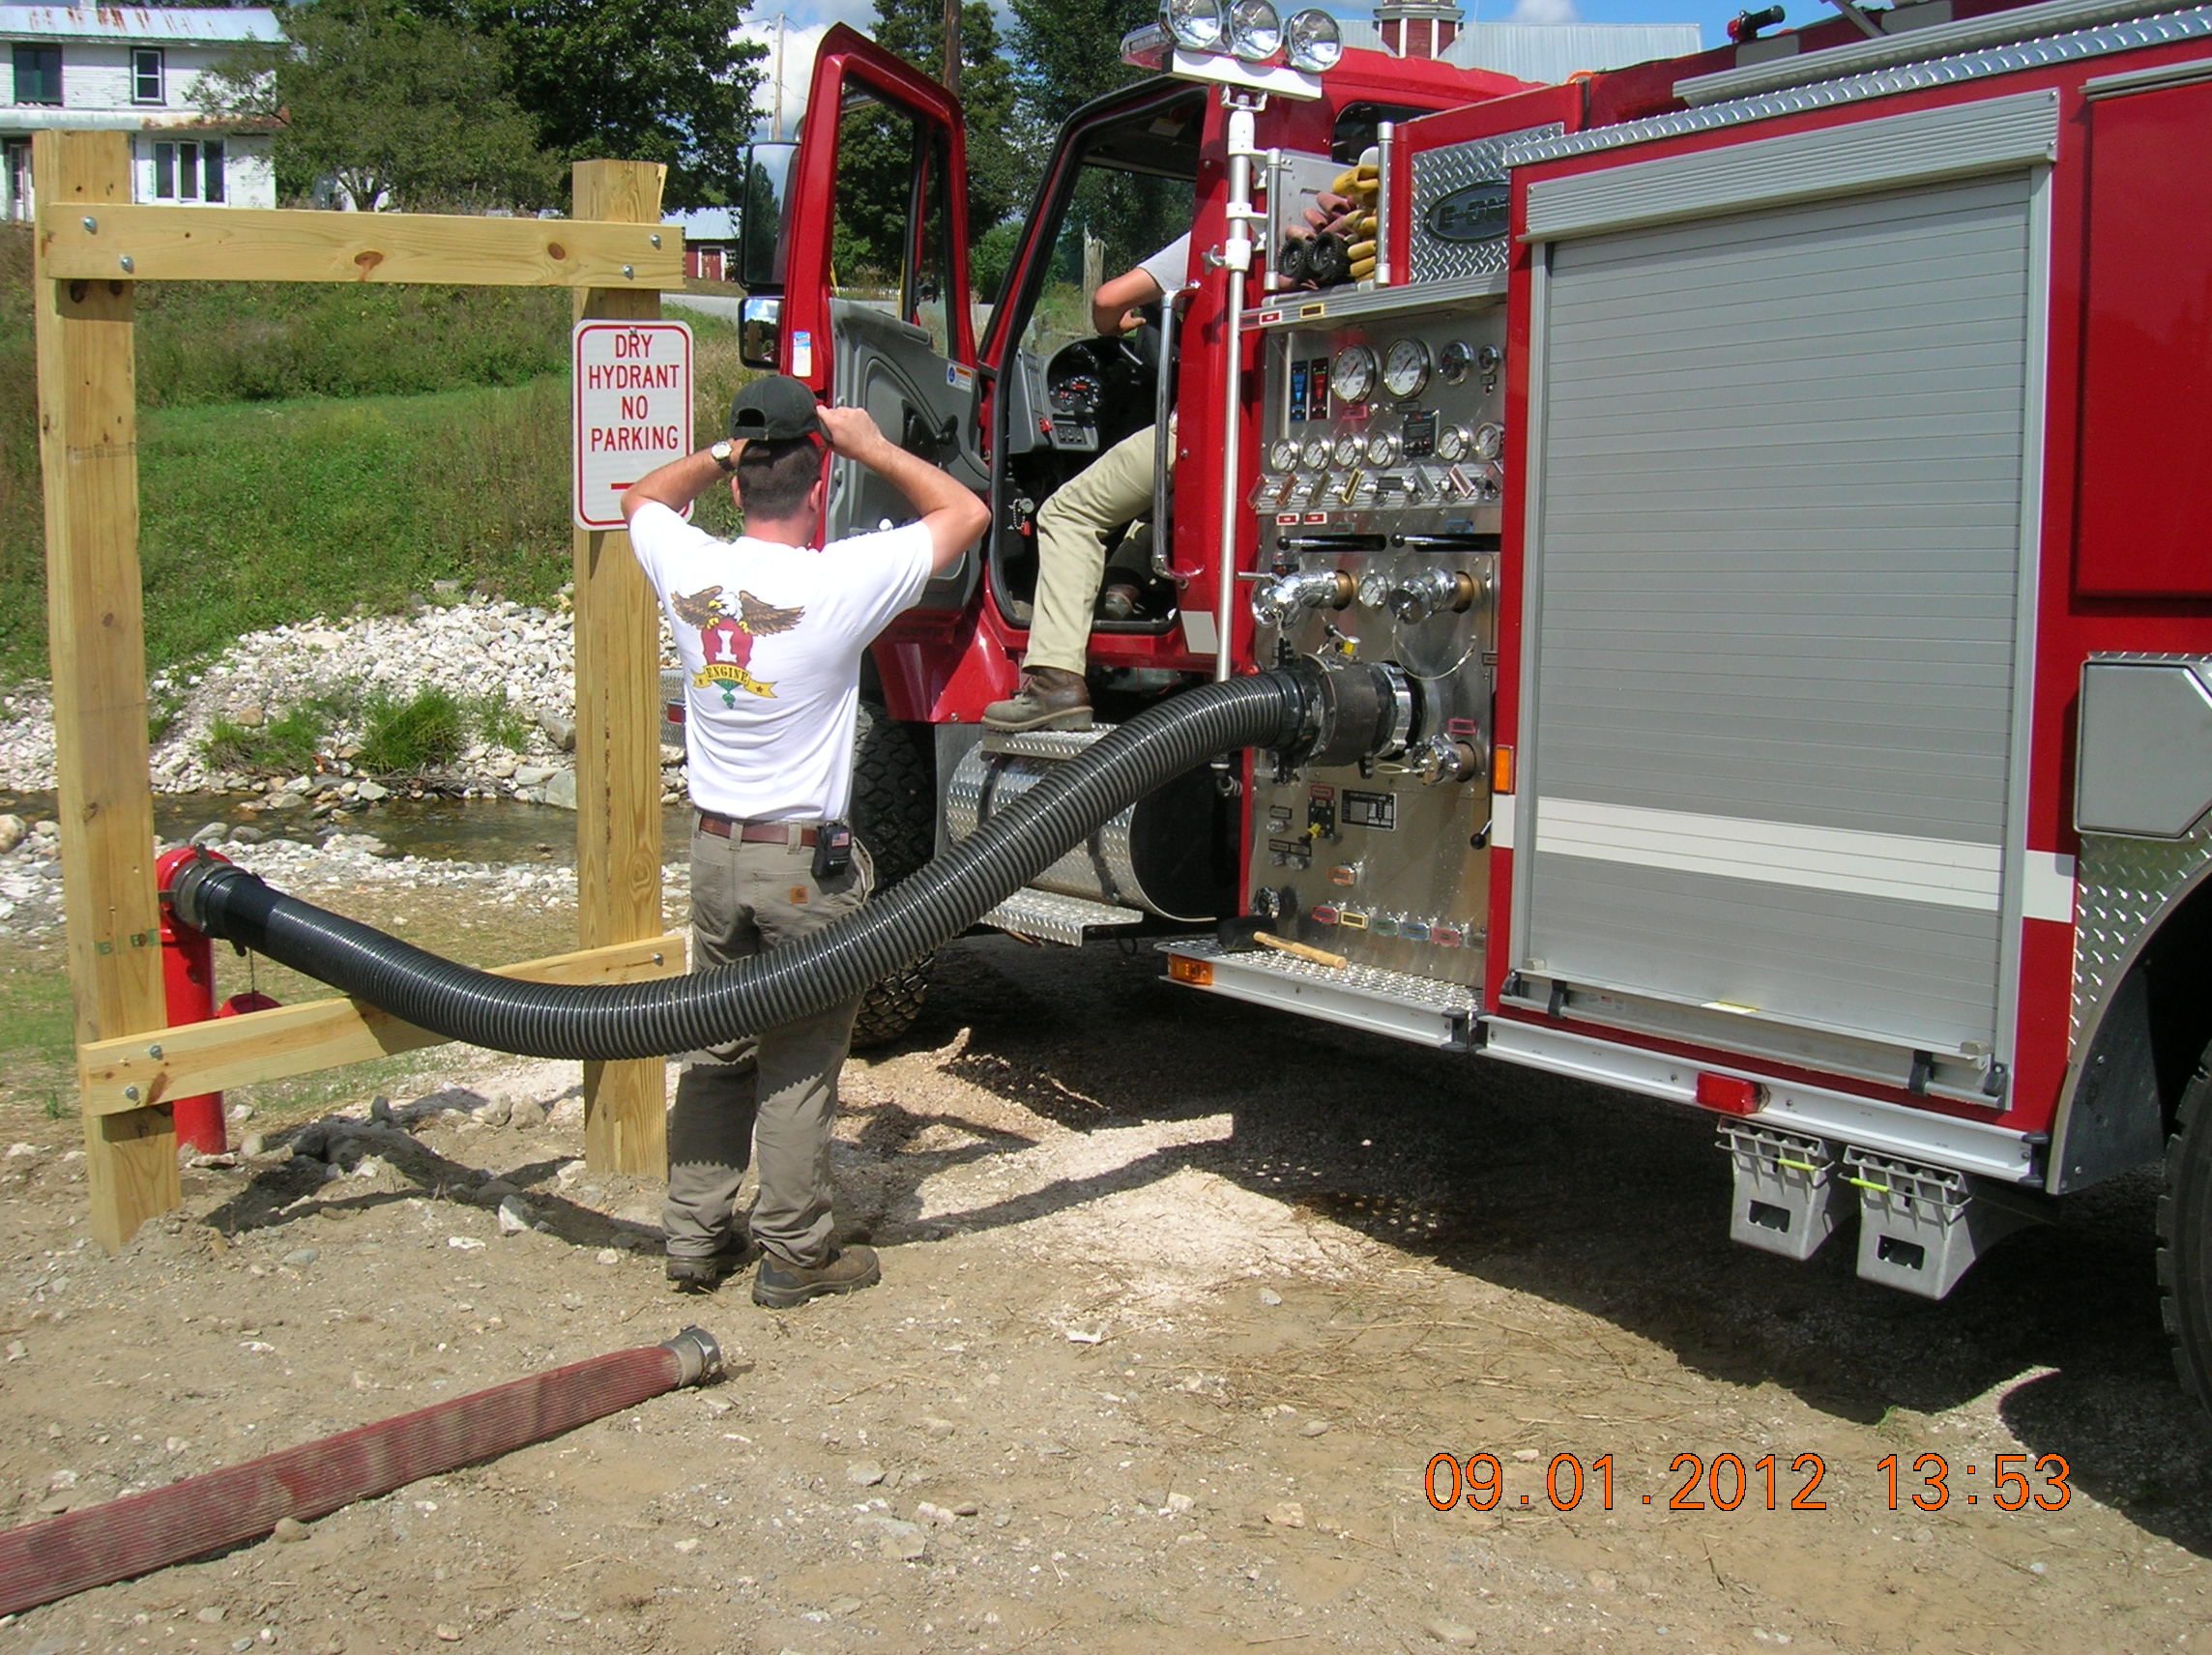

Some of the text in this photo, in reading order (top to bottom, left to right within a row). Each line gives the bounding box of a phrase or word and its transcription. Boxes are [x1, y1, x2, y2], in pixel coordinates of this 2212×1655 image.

[615, 334, 653, 358] DRY
[588, 364, 680, 390] HYDRANT
[621, 395, 649, 420] NO
[591, 425, 679, 451] PARKING
[705, 665, 749, 682] ENGINE
